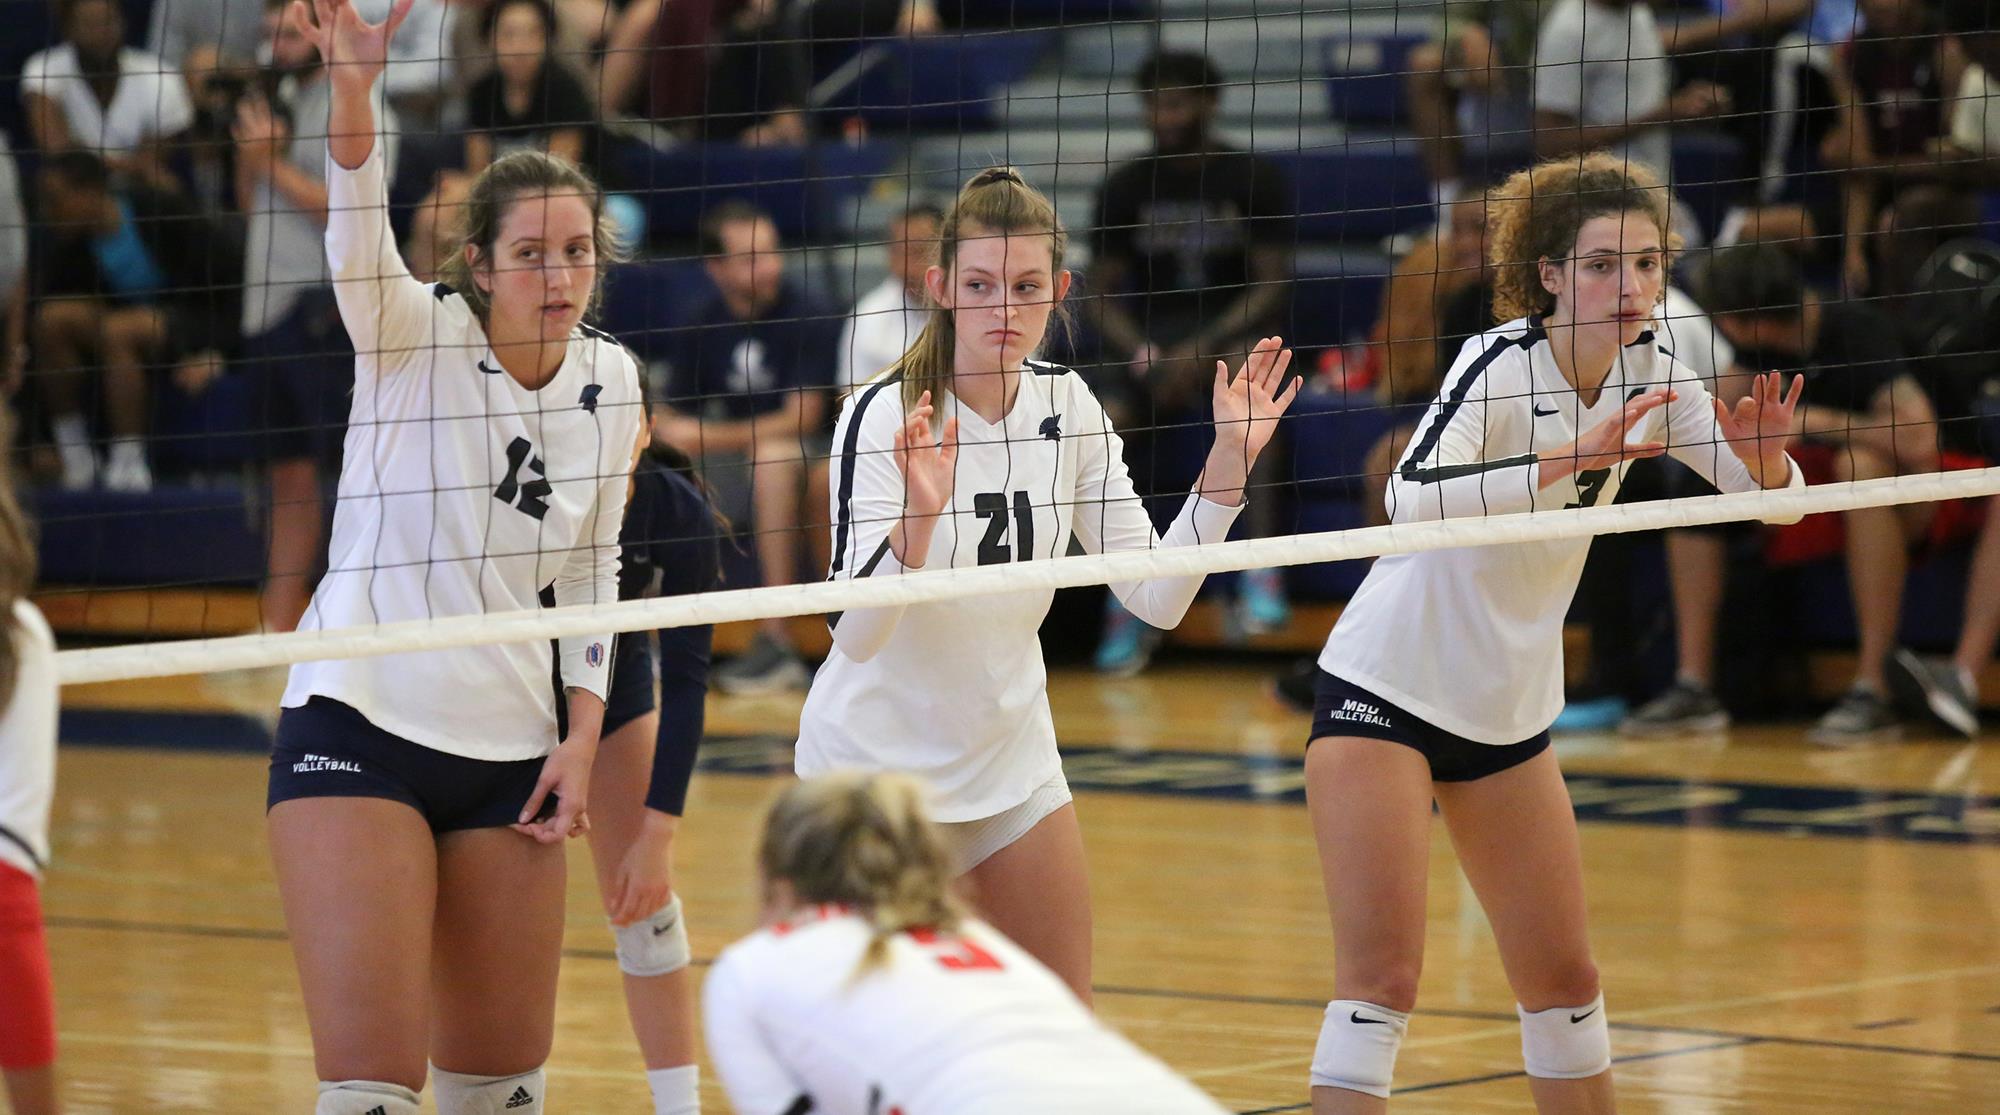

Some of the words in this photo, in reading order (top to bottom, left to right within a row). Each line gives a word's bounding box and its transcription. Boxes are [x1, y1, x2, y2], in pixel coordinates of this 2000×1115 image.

[974, 490, 1034, 566] 21
[1330, 709, 1392, 728] VOLLEYBALL
[293, 760, 362, 773] VOLLEYBALL
